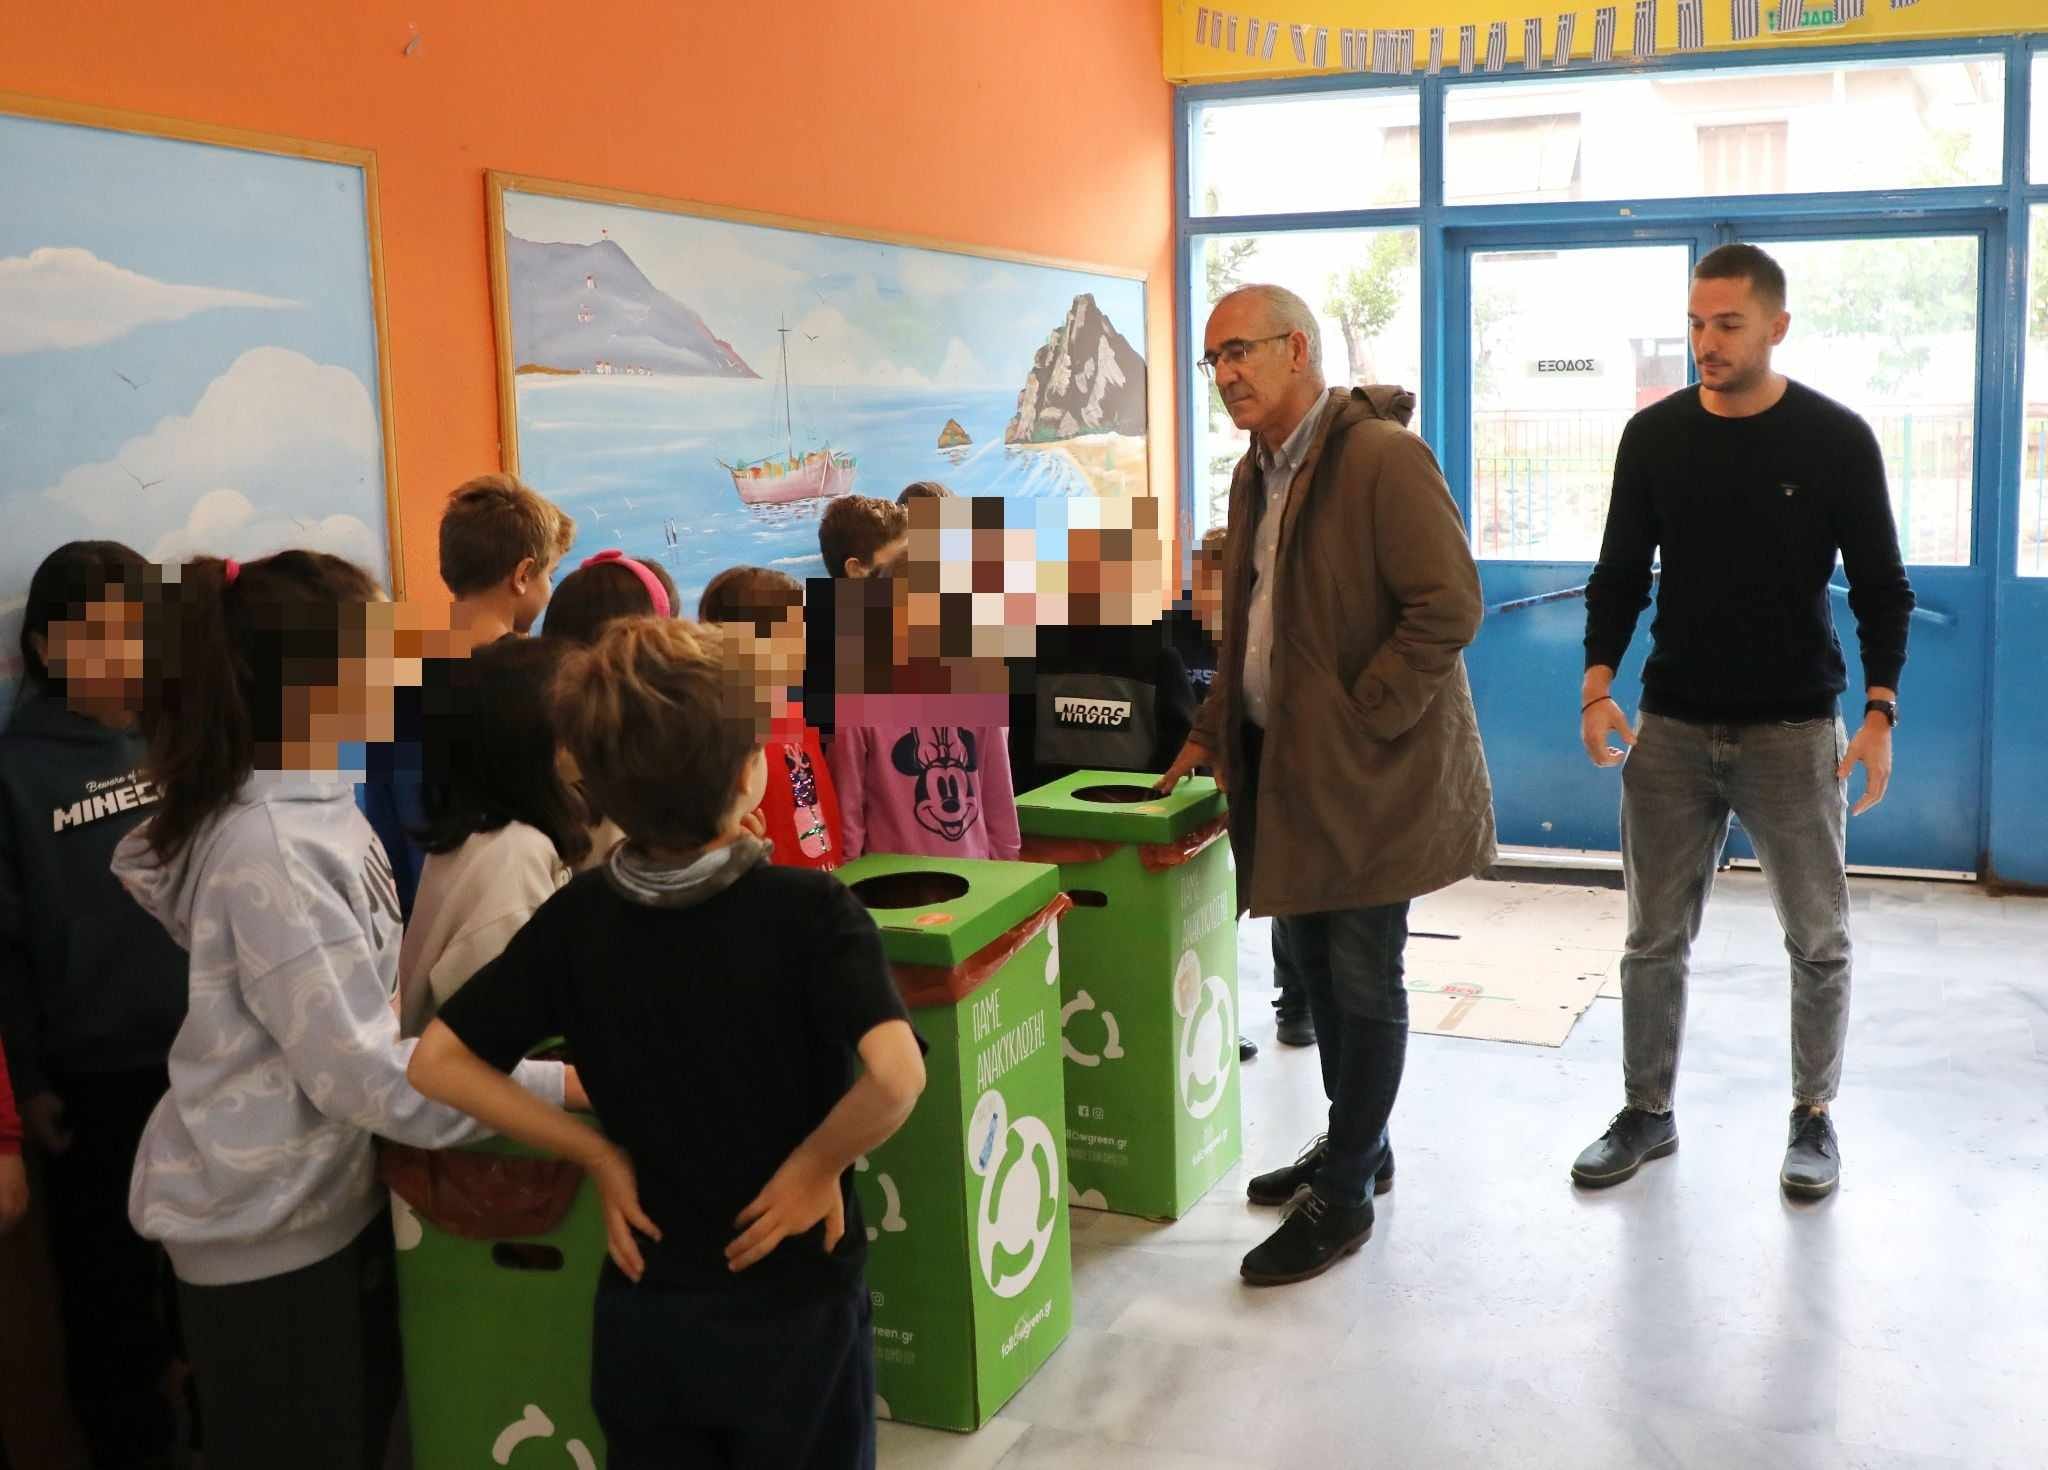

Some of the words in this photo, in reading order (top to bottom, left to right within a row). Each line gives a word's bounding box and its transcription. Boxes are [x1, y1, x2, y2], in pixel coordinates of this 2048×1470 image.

[1537, 358, 1595, 373] ΕΞΟΔΟΣ
[1061, 703, 1125, 725] NRGRS
[86, 776, 126, 793] Beware
[53, 781, 167, 832] MINEC
[972, 988, 1002, 1042] ΠΑΜΕ
[977, 1008, 1046, 1094] ΑΝΑΚΥΚΛΩΣΗ!
